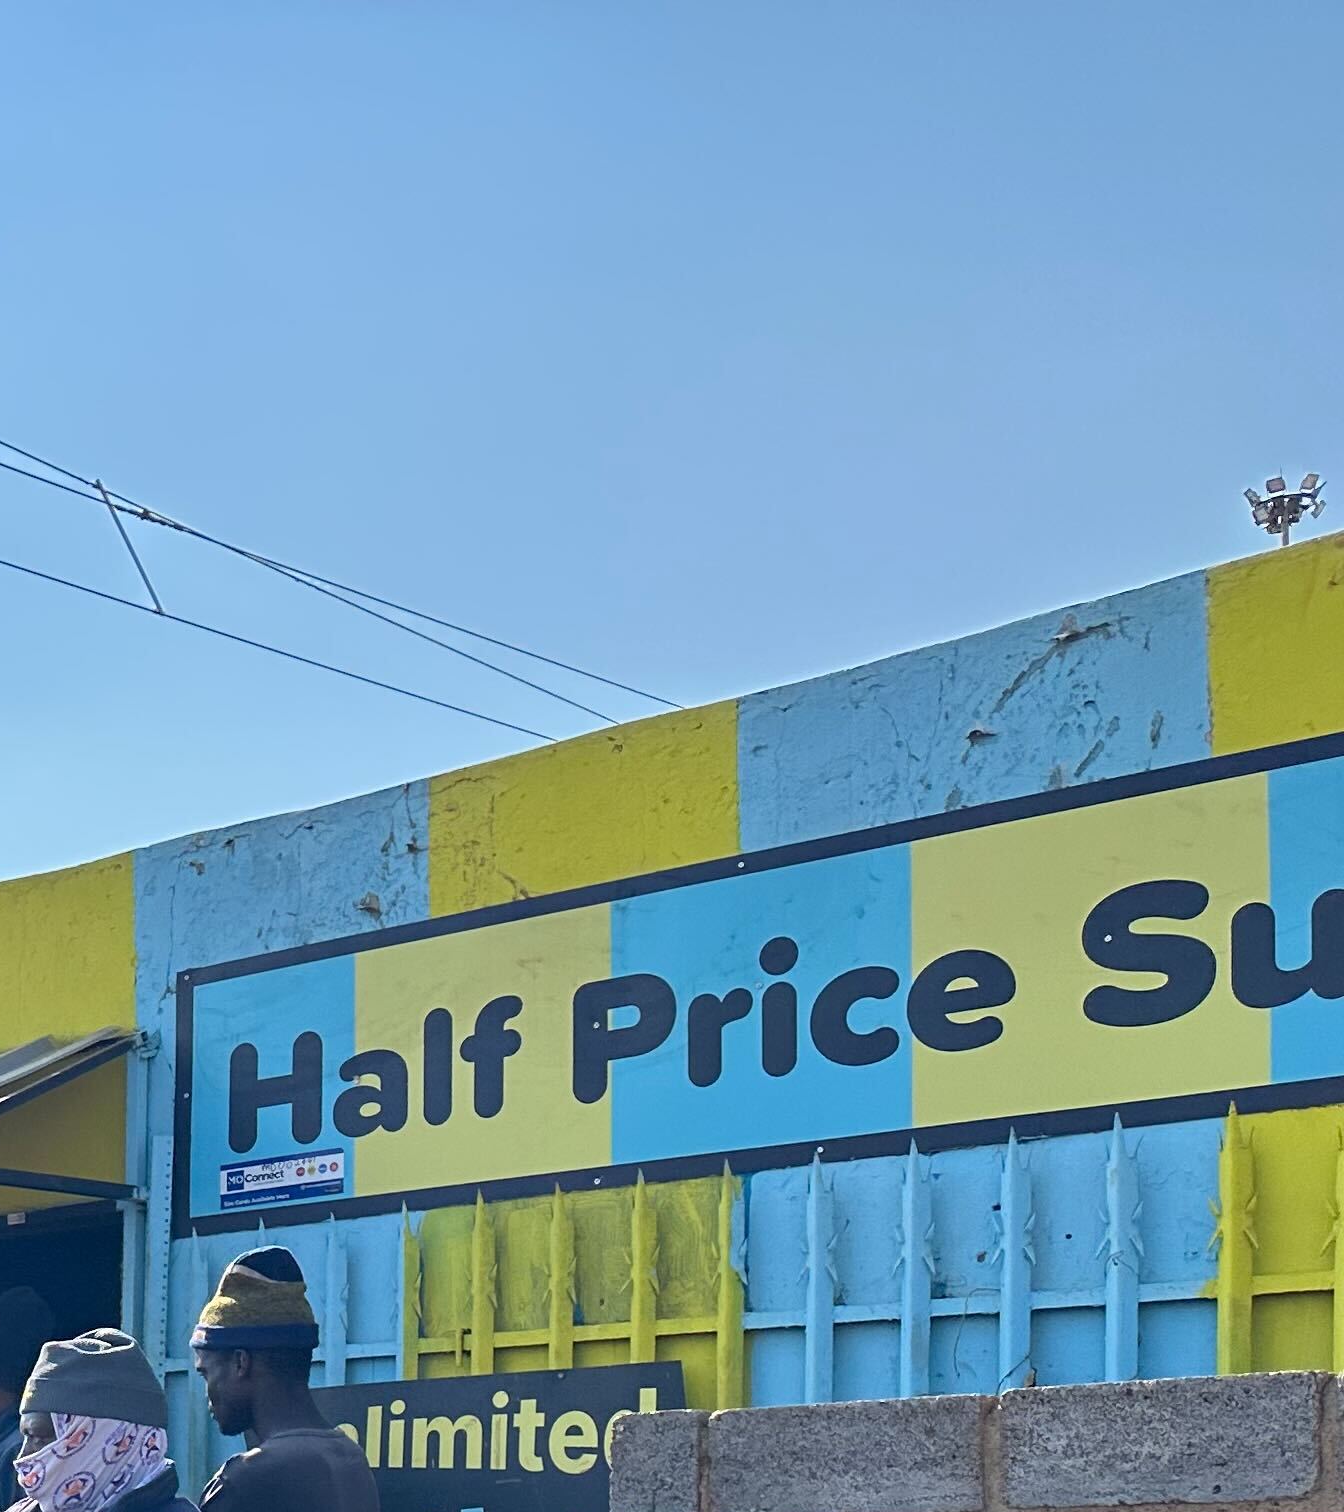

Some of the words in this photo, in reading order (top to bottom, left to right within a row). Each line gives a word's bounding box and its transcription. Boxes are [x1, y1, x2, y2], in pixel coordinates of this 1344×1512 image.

[226, 994, 522, 1154] Half
[572, 936, 1018, 1104] Price
[1081, 878, 1344, 1028] Su
[244, 1171, 285, 1183] Connect
[333, 1387, 657, 1475] limite
